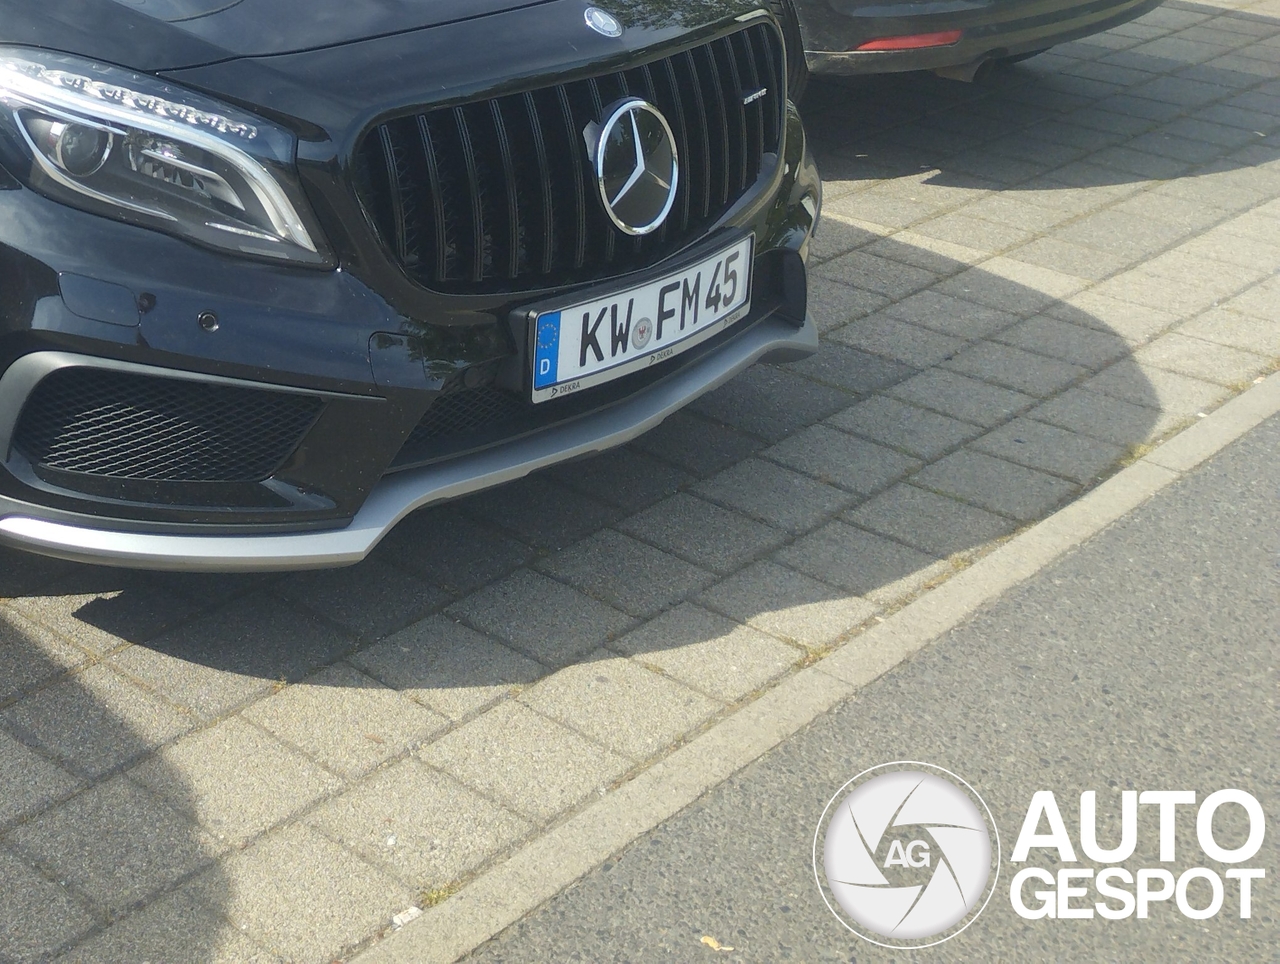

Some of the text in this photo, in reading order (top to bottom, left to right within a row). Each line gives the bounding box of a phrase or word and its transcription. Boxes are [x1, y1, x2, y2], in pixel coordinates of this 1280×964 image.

[579, 298, 634, 367] KW
[656, 348, 674, 361] DEKRA
[540, 358, 550, 375] D
[559, 381, 581, 394] DEKRA
